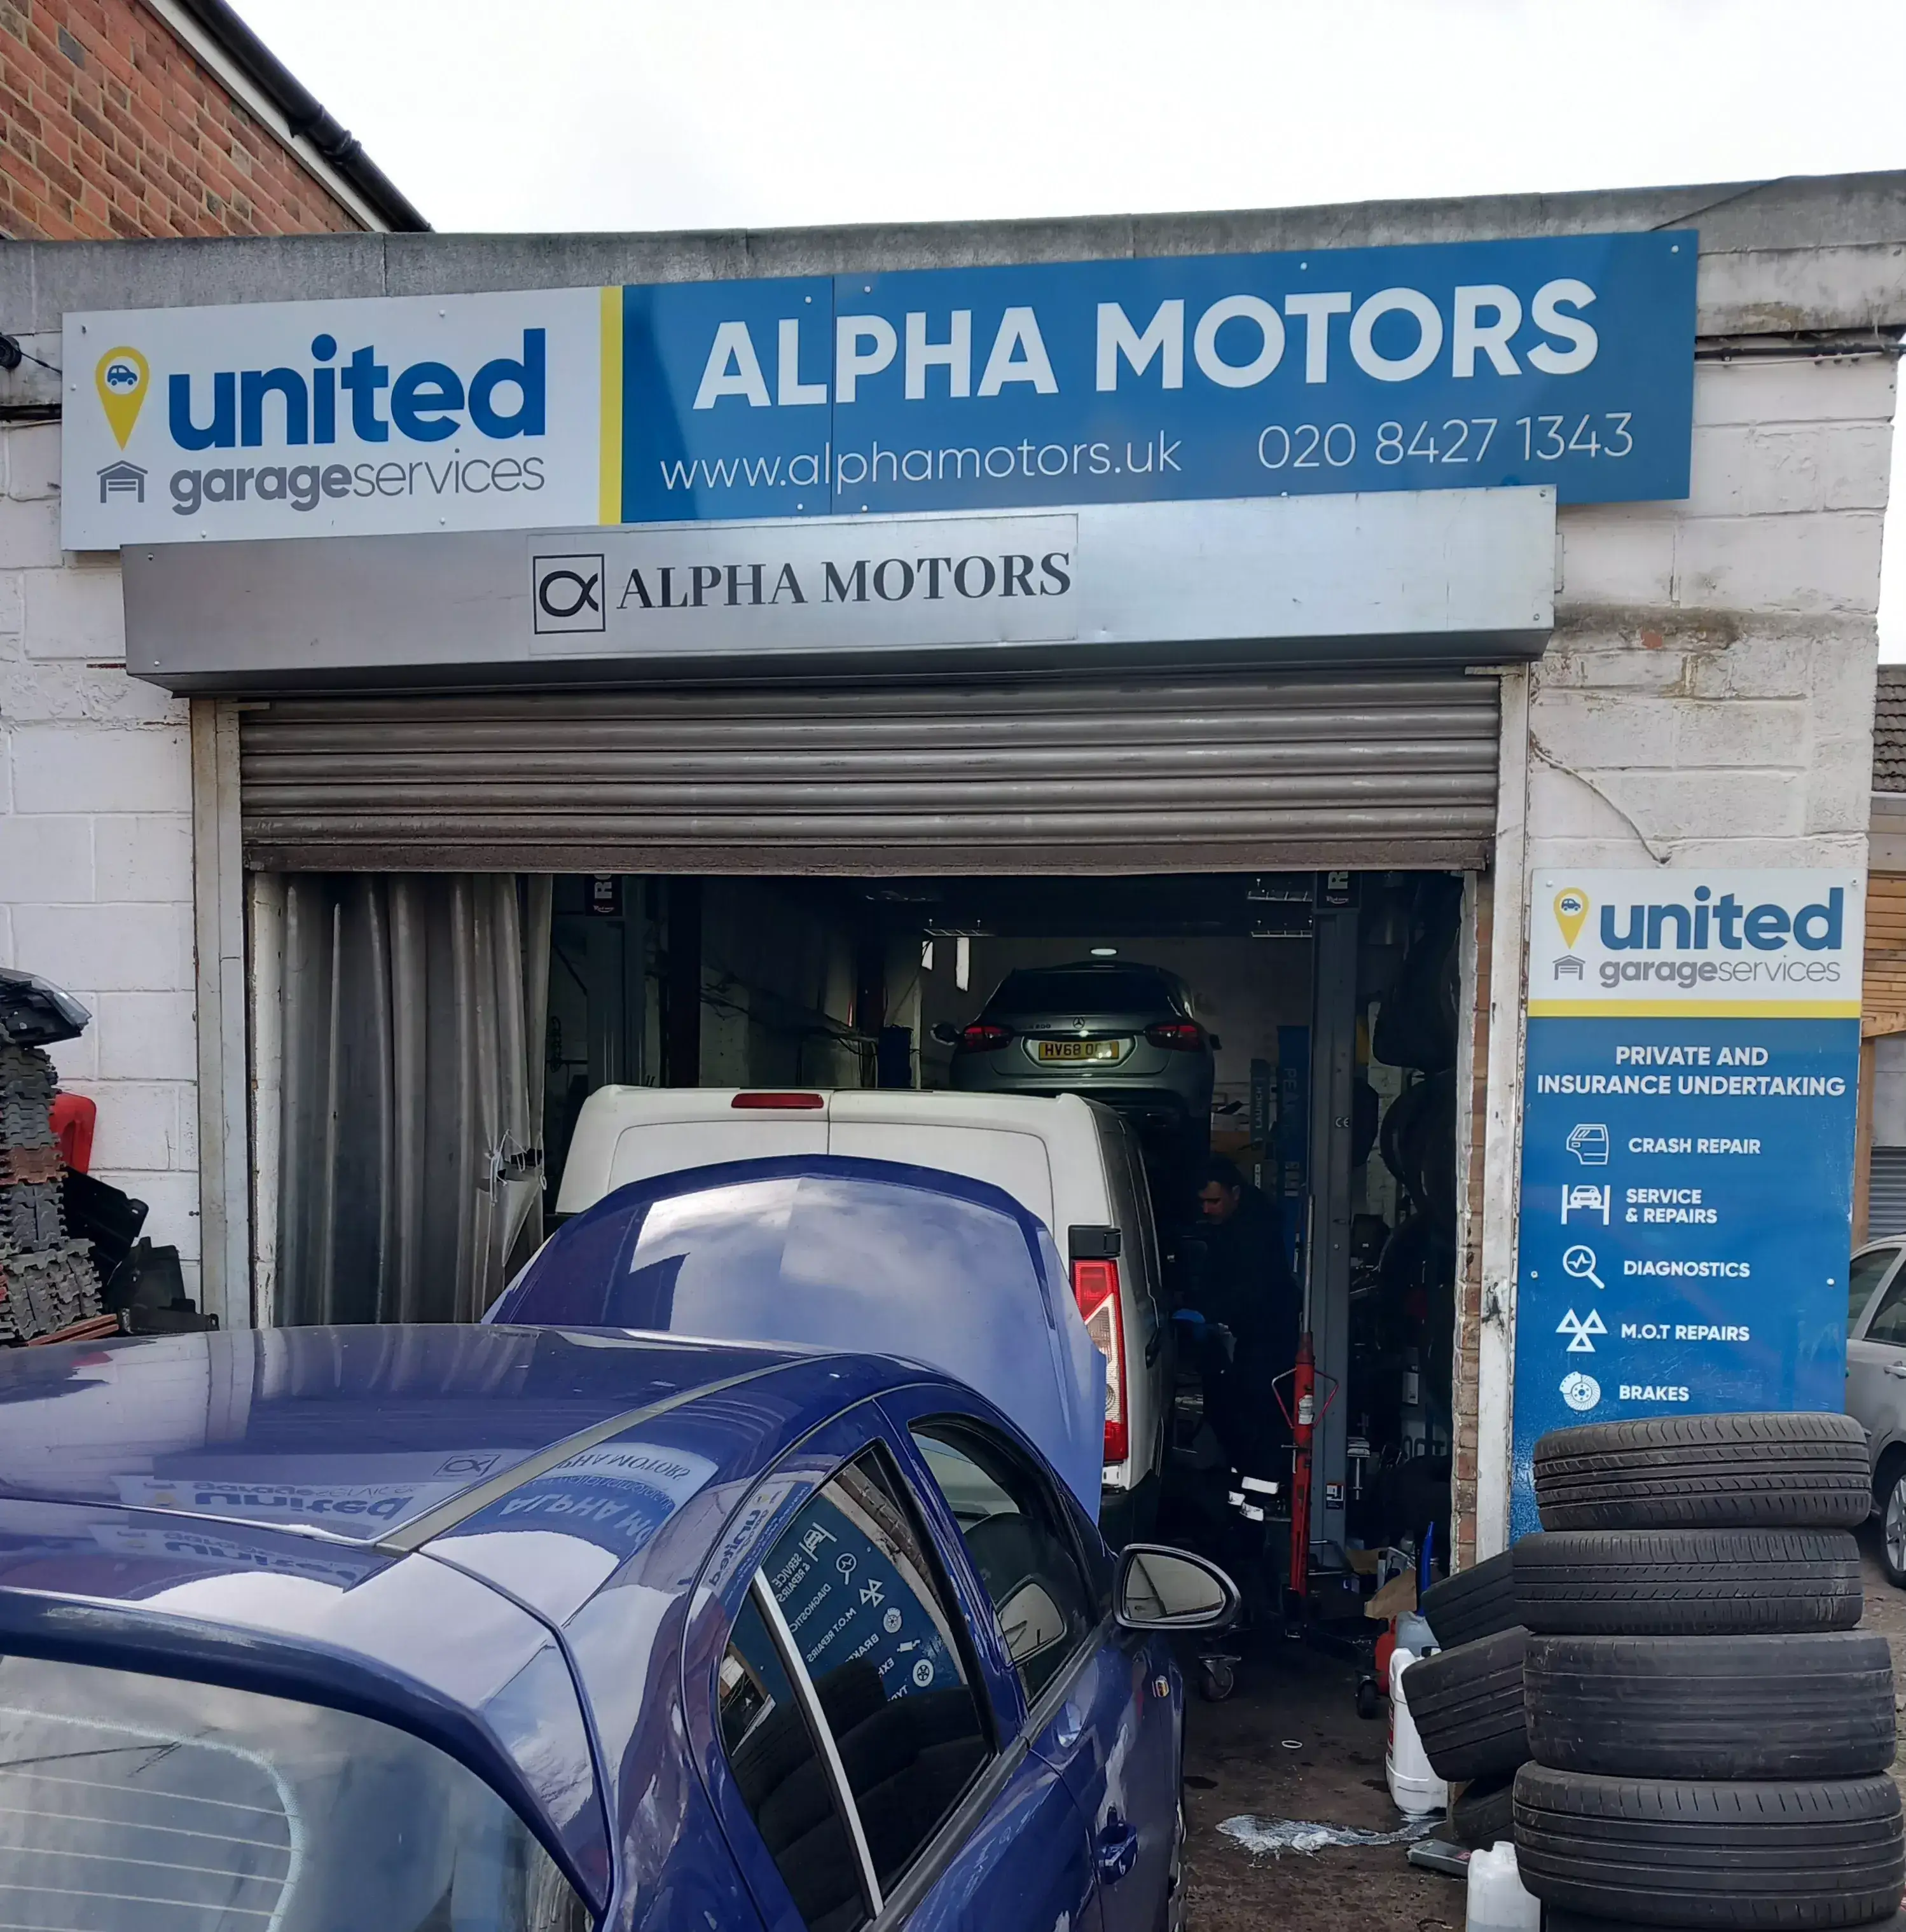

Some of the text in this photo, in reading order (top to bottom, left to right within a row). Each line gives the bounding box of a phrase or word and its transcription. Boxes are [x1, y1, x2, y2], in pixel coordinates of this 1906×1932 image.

[693, 279, 1598, 409] ALPHA MOTORS
[169, 328, 545, 450] united
[1259, 413, 1632, 468] 020 8427 1343
[661, 431, 1181, 494] www.alphamotors.uk
[170, 448, 545, 515] garageservices
[616, 553, 1070, 609] ALPHA MOTORS
[1601, 886, 1843, 950] united
[1599, 955, 1841, 989] garageservices
[1045, 1044, 1081, 1056] HV68
[1616, 1047, 1768, 1065] PRIVATE AND
[1538, 1075, 1845, 1096] INSURANCE UNDERTAKING
[1255, 1086, 1263, 1129] LAUNCH
[1629, 1138, 1760, 1154] CRASH REPAIR
[1626, 1189, 1701, 1204] SERVICE
[1626, 1208, 1717, 1223] & REPAIRS
[1624, 1260, 1750, 1277] DIAGNOSTICS
[1622, 1324, 1749, 1341] M.O.T REPAIRS
[1620, 1385, 1689, 1401] BRAKES
